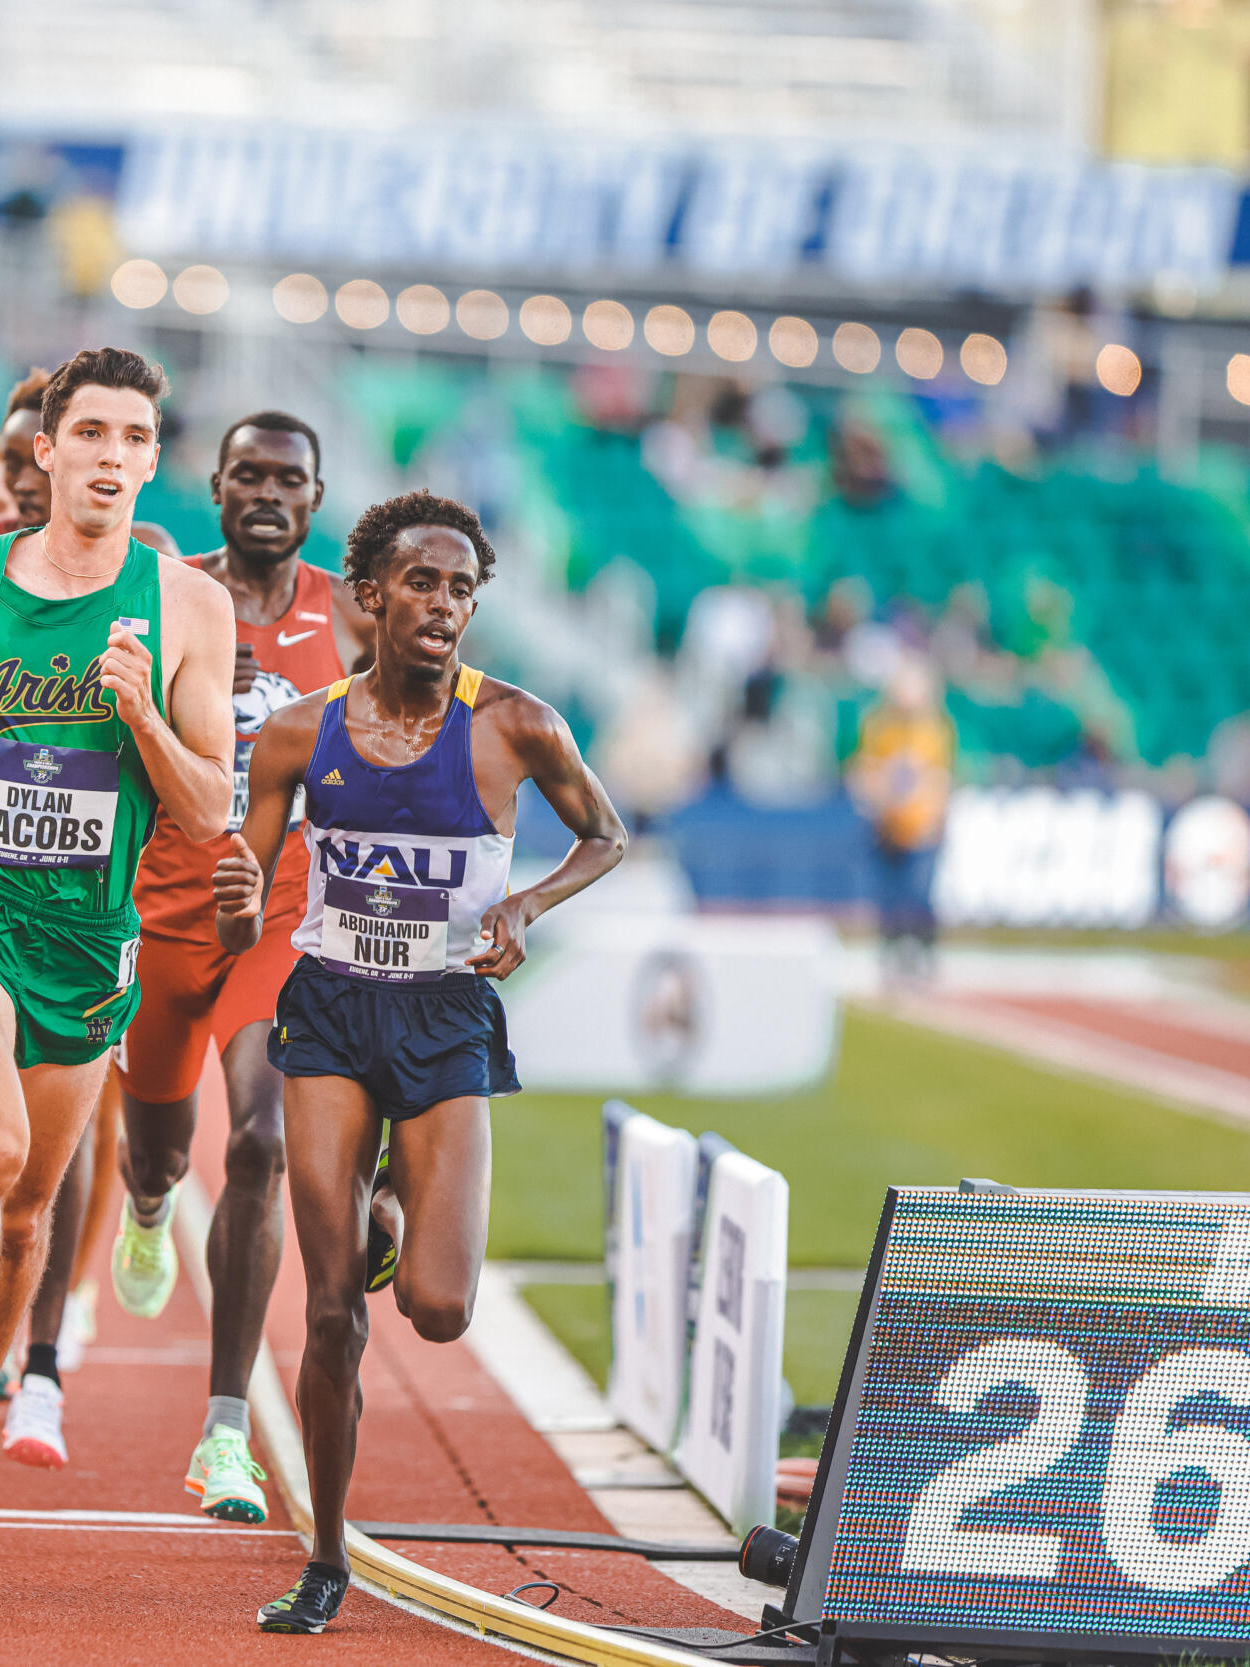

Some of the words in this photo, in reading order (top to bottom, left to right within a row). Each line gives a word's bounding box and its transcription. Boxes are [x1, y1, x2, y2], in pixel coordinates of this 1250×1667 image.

[321, 778, 344, 786] adidas
[6, 786, 73, 814] DYLAN
[39, 855, 55, 863] JUNE
[316, 837, 467, 889] NAU
[338, 912, 430, 939] ABDIHAMID
[354, 934, 410, 967] NUR
[899, 1338, 1250, 1593] 26
